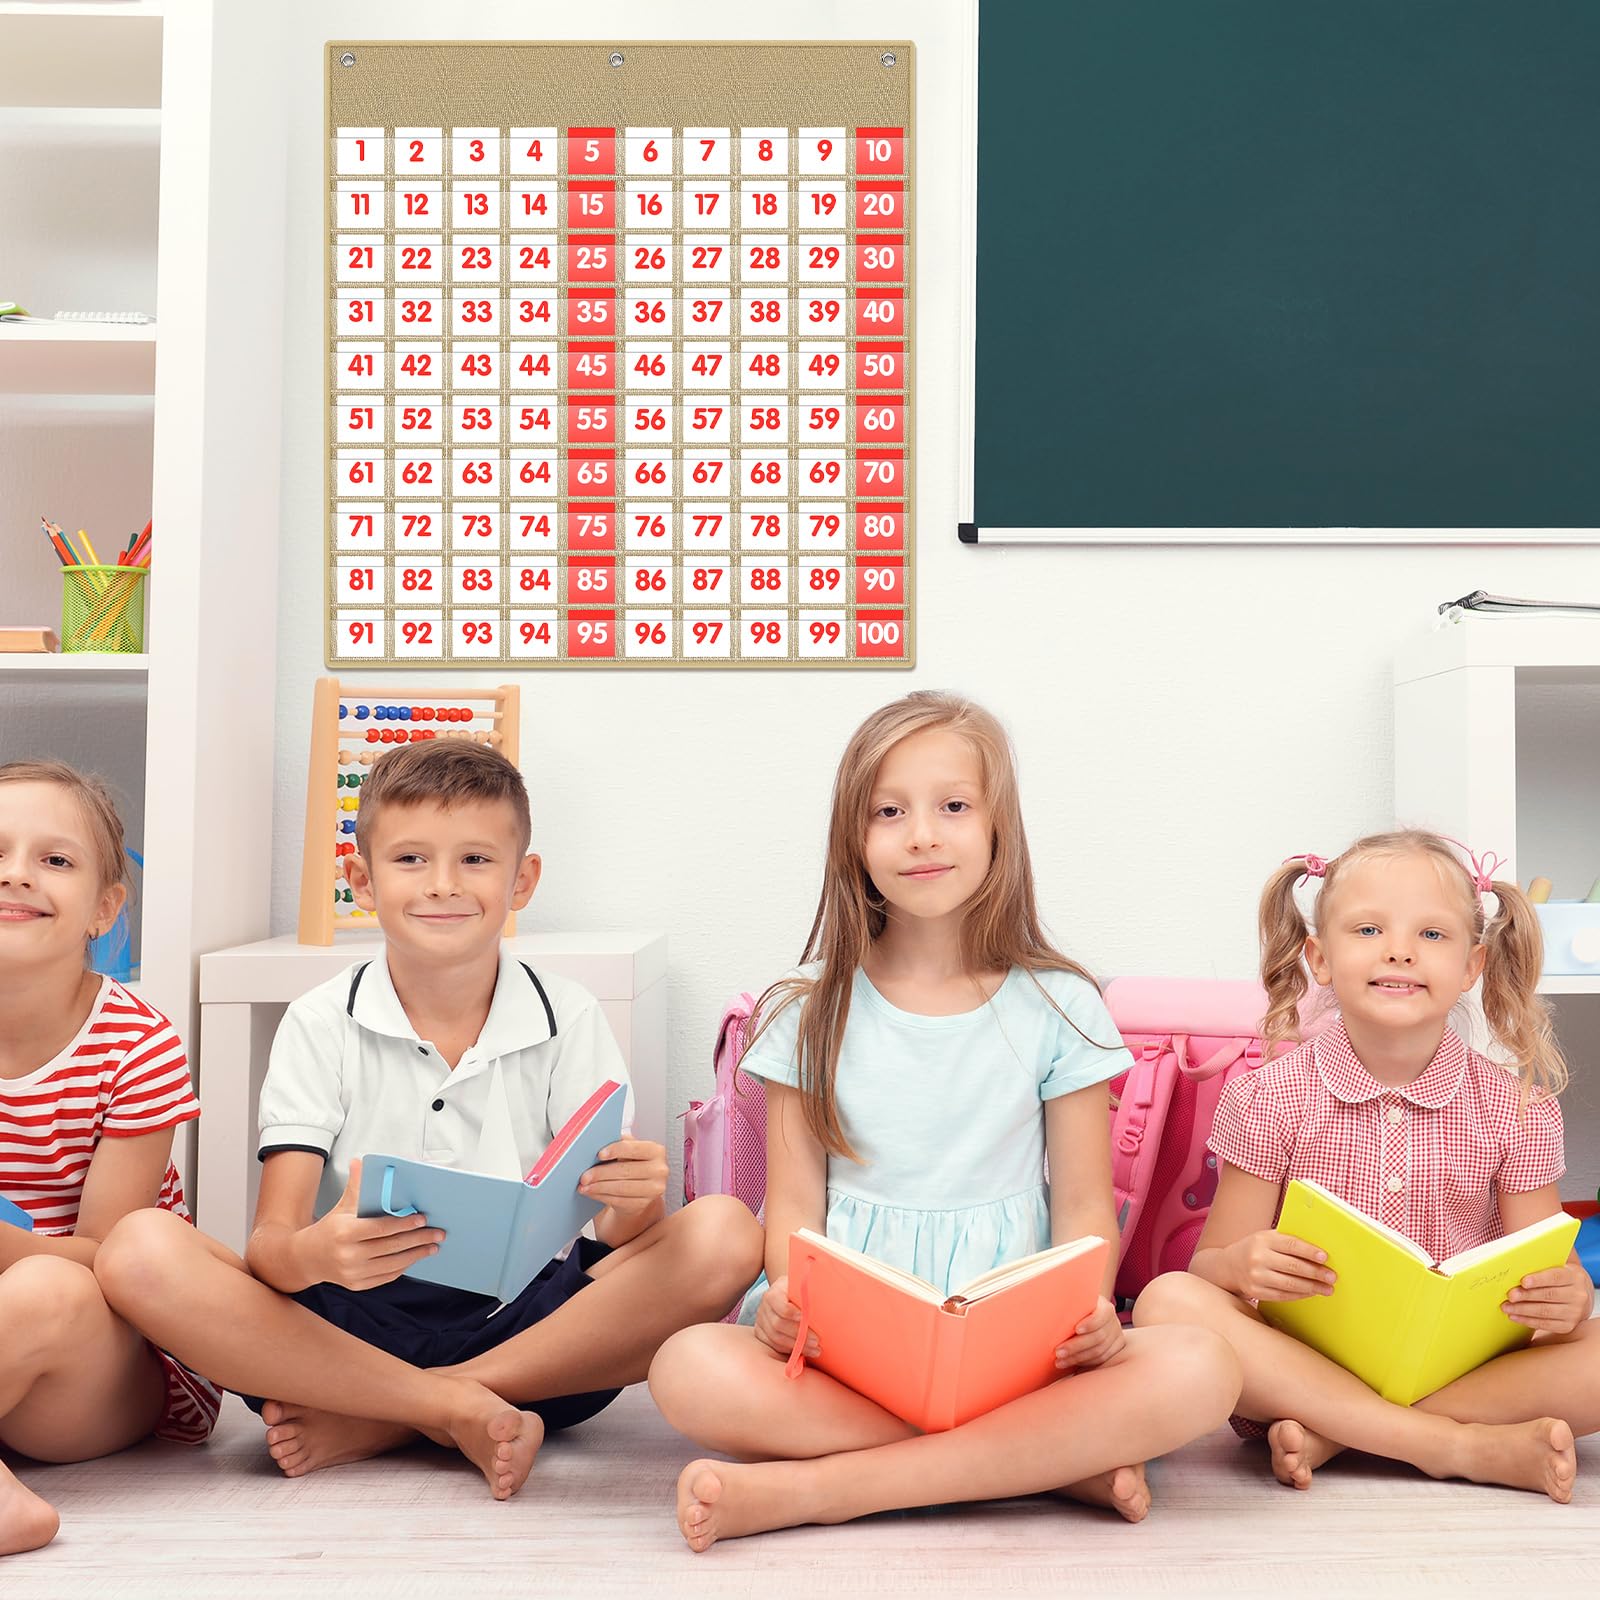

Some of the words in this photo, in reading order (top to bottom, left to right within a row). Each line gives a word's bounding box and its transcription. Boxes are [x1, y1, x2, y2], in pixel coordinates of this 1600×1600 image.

[355, 139, 365, 161] 1
[409, 139, 425, 163] 2
[469, 139, 485, 163] 3
[527, 139, 543, 162] 4
[584, 139, 600, 162] 5
[643, 139, 659, 163] 6
[699, 139, 716, 162] 7
[757, 139, 773, 162] 8
[817, 139, 833, 161] 9
[865, 139, 892, 162] 10
[351, 193, 370, 216] 11
[403, 192, 429, 216] 12
[463, 193, 489, 216] 13
[521, 193, 548, 216] 14
[579, 193, 604, 216] 15
[637, 193, 663, 216] 16
[694, 193, 720, 216] 17
[752, 193, 778, 216] 18
[811, 192, 837, 216] 19
[863, 193, 895, 216] 20
[348, 246, 373, 269] 21
[401, 247, 432, 270] 22
[461, 246, 493, 270] 23
[519, 246, 551, 269] 24
[576, 246, 607, 269] 25
[634, 247, 666, 270] 26
[691, 246, 723, 269] 27
[749, 246, 781, 270] 28
[809, 246, 840, 269] 29
[863, 246, 895, 269] 30
[348, 300, 374, 323] 31
[401, 300, 433, 323] 32
[461, 300, 493, 323] 33
[519, 300, 551, 323] 34
[576, 300, 608, 323] 35
[634, 300, 666, 324] 36
[692, 300, 723, 323] 37
[750, 300, 781, 323] 38
[808, 300, 840, 323] 39
[862, 300, 895, 323] 40
[347, 353, 373, 377] 41
[400, 353, 432, 377] 42
[460, 353, 493, 377] 43
[518, 353, 551, 377] 44
[575, 354, 607, 377] 45
[633, 353, 666, 377] 46
[691, 353, 723, 377] 47
[748, 353, 781, 377] 48
[808, 353, 840, 377] 49
[863, 354, 895, 377] 50
[348, 407, 374, 430] 51
[401, 407, 432, 431] 52
[461, 407, 493, 431] 53
[519, 407, 551, 431] 54
[576, 407, 608, 430] 55
[634, 408, 666, 431] 56
[691, 407, 723, 430] 57
[749, 407, 781, 431] 58
[808, 407, 841, 430] 59
[863, 408, 895, 431] 60
[348, 461, 374, 484] 61
[401, 461, 433, 485] 62
[461, 461, 493, 485] 63
[519, 461, 551, 484] 64
[577, 462, 608, 484] 65
[634, 461, 667, 485] 66
[692, 461, 724, 484] 67
[750, 461, 782, 485] 68
[809, 461, 841, 484] 69
[863, 461, 895, 484] 70
[348, 514, 373, 537] 71
[401, 514, 432, 537] 72
[462, 514, 493, 538] 73
[519, 514, 551, 537] 74
[577, 515, 607, 537] 75
[634, 515, 666, 538] 76
[692, 514, 723, 537] 77
[750, 514, 781, 538] 78
[809, 514, 841, 537] 79
[863, 515, 896, 538] 80
[348, 568, 374, 591] 81
[402, 568, 433, 591] 82
[462, 568, 493, 591] 83
[519, 568, 551, 591] 84
[577, 568, 608, 591] 85
[635, 568, 667, 592] 86
[692, 568, 724, 591] 87
[750, 568, 782, 591] 88
[809, 567, 841, 591] 89
[863, 568, 895, 591] 90
[348, 621, 374, 645] 91
[401, 621, 433, 645] 92
[461, 621, 493, 645] 93
[519, 622, 551, 645] 94
[577, 621, 608, 644] 95
[634, 622, 667, 645] 96
[692, 621, 724, 645] 97
[750, 621, 782, 645] 98
[809, 621, 841, 645] 99
[857, 622, 900, 645] 100
